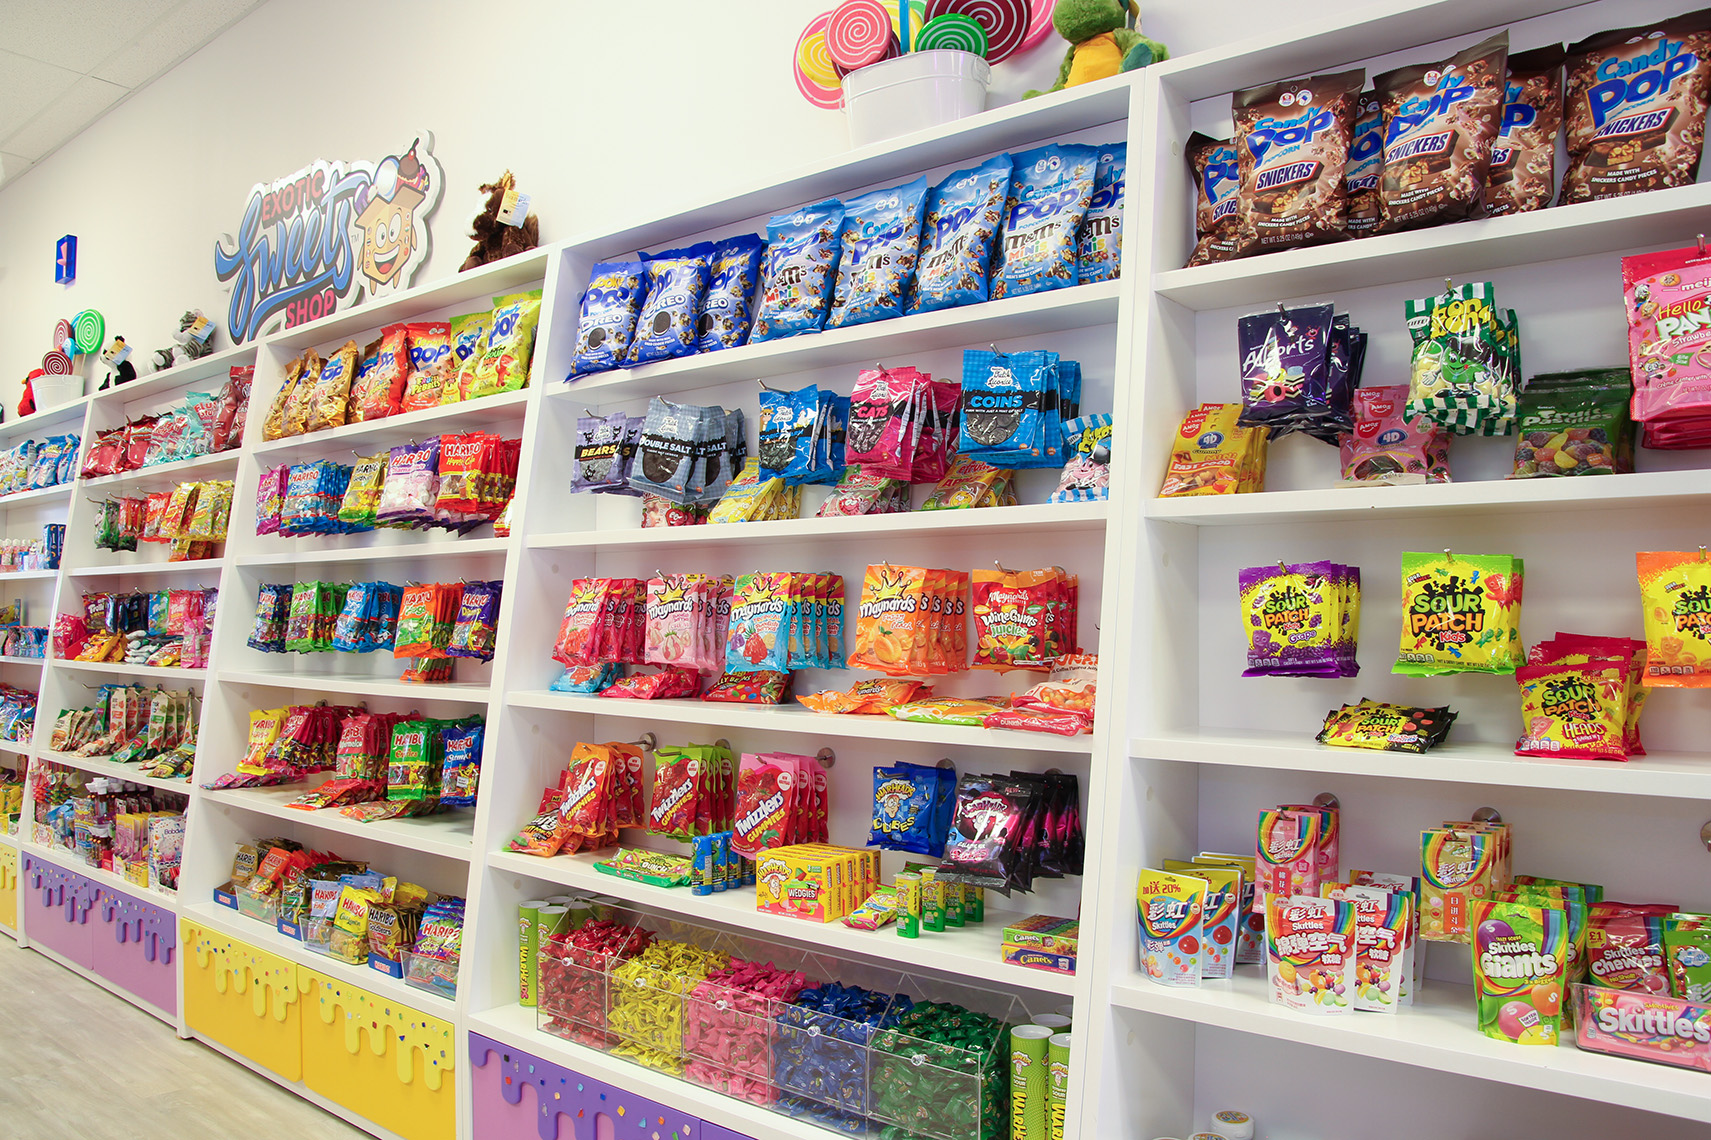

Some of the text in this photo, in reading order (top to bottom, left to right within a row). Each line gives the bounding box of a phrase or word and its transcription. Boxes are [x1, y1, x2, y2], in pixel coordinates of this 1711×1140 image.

[1596, 38, 1685, 82] Candy
[1585, 52, 1699, 130] POP
[1254, 105, 1323, 131] Candy
[1594, 110, 1668, 139] SNICKERS
[1245, 110, 1335, 171] POP
[1385, 133, 1449, 164] SNICKERS
[1256, 162, 1315, 190] SNICKERS
[1591, 169, 1657, 184] SNICKERS CANDY PIECES
[1607, 167, 1640, 177] MADE WITH
[262, 169, 324, 222] EXOTIC
[1400, 190, 1415, 198] MADE
[1007, 187, 1081, 232] POP
[215, 168, 371, 342] Sweets
[285, 289, 335, 330] SHOP
[644, 294, 687, 320] OREO
[701, 297, 729, 313] REO
[1658, 300, 1702, 320] Hello
[488, 313, 520, 348] POP
[581, 313, 623, 334] OREO
[1656, 306, 1711, 341] PAN
[1672, 331, 1711, 348] Strawbe
[409, 344, 451, 373] POP
[970, 395, 1023, 408] COINS
[1371, 403, 1391, 411] AMOS
[857, 404, 889, 418] CATS
[1522, 411, 1614, 427] Pastilles
[1537, 407, 1601, 419] Fruit
[1183, 422, 1200, 432] AMOS
[1360, 421, 1379, 430] AMOS
[639, 435, 669, 451] DOUBLE
[669, 442, 692, 455] SALT
[1382, 431, 1400, 443] 4D
[391, 448, 431, 466] HARBO
[444, 441, 481, 457] HARIBO
[580, 444, 616, 458] BEARS
[1174, 459, 1231, 470] FAST FOOD
[290, 470, 319, 482] HARIBO
[1264, 594, 1307, 613] SOUR
[1414, 593, 1481, 613] SOUR
[1675, 600, 1711, 614] SOU
[753, 613, 781, 623] TROPICAL
[1264, 608, 1310, 629] PATCH
[1283, 621, 1301, 630] Kids
[1411, 612, 1484, 634] PATCH
[1288, 628, 1317, 645] Grape
[1439, 631, 1467, 643] Kids
[1542, 685, 1594, 706] SOUR
[1544, 698, 1601, 716] PATCH
[1356, 724, 1397, 733] PATCH
[1361, 717, 1399, 726] SOUR
[1563, 723, 1602, 738] HEADS
[650, 778, 692, 824] Twizzlers
[875, 783, 916, 802] WARHEADS
[565, 790, 597, 821] GUMMIES
[661, 791, 693, 827] GUMMIES
[735, 790, 784, 838] Twizzlers
[747, 808, 786, 843] GUMMIES
[872, 815, 915, 833] CUBES
[1268, 837, 1302, 853] 彩虹
[758, 862, 792, 880] WARHEADS
[1435, 860, 1477, 878] 彩虹
[787, 887, 816, 898] WEDGIES
[1162, 883, 1181, 894] 20%
[342, 898, 367, 918] HARIBO
[368, 907, 396, 926] HARIBO
[1147, 900, 1188, 922] 彩虹
[1288, 905, 1326, 922] 彩虹
[368, 922, 393, 936] Goldbears
[422, 923, 462, 940] HARIBO
[1152, 920, 1177, 931] Skittles
[1292, 921, 1324, 931] Skittles
[1485, 923, 1496, 933] S
[1588, 931, 1604, 942] £1
[1488, 941, 1536, 955] Skittles
[1603, 946, 1646, 961] Skittles
[519, 946, 530, 1001] WARHEADS
[1480, 951, 1559, 979] Giants
[1548, 991, 1559, 1004] S
[1506, 1005, 1518, 1016] S
[1643, 1002, 1679, 1011] SMOOTHIES
[1598, 1007, 1711, 1044] Skittles
[1540, 1031, 1551, 1041] S
[1012, 1090, 1028, 1140] WARHE
